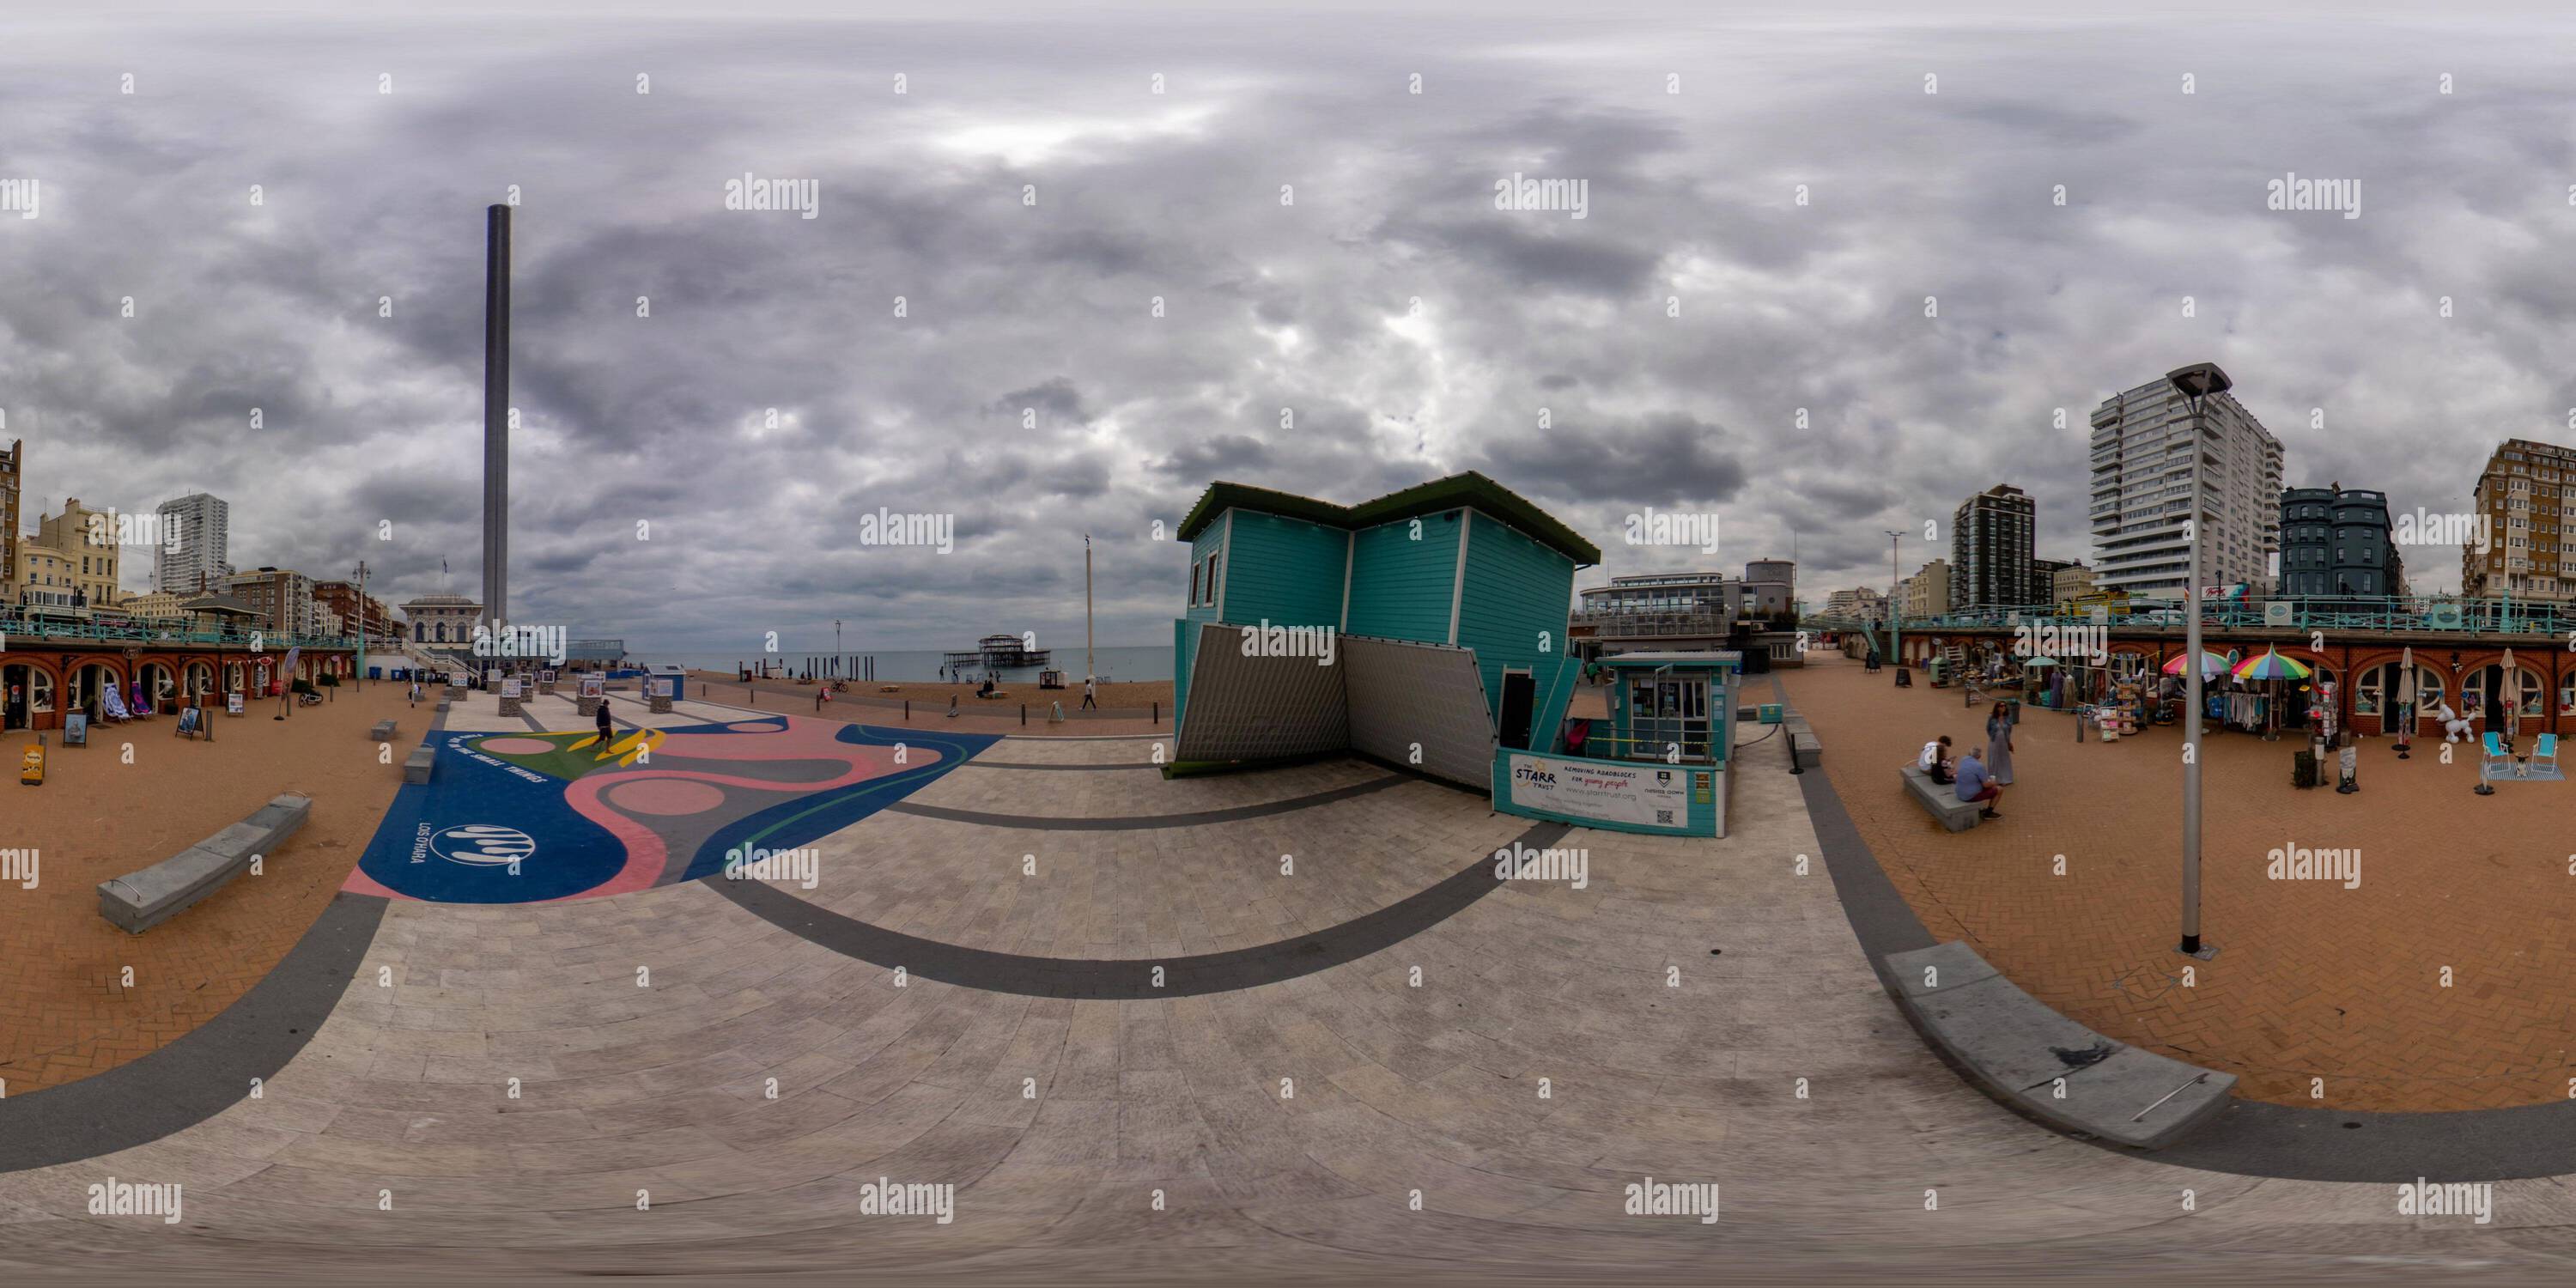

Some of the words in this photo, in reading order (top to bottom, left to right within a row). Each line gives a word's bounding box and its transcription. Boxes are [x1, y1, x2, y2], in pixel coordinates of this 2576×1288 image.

[470, 754, 505, 767] SMALL
[503, 765, 550, 783] THINGS
[1564, 766, 1595, 775] REMOVING
[1597, 769, 1637, 779] ROADBLOCKS
[1516, 769, 1556, 784] STARR
[1584, 778, 1603, 788] young
[1604, 779, 1628, 789] people
[1533, 782, 1554, 791] TRUST
[1565, 787, 1637, 801] www.starrtrust.org
[417, 823, 431, 837] LOIS
[410, 837, 428, 864] O'HARA
